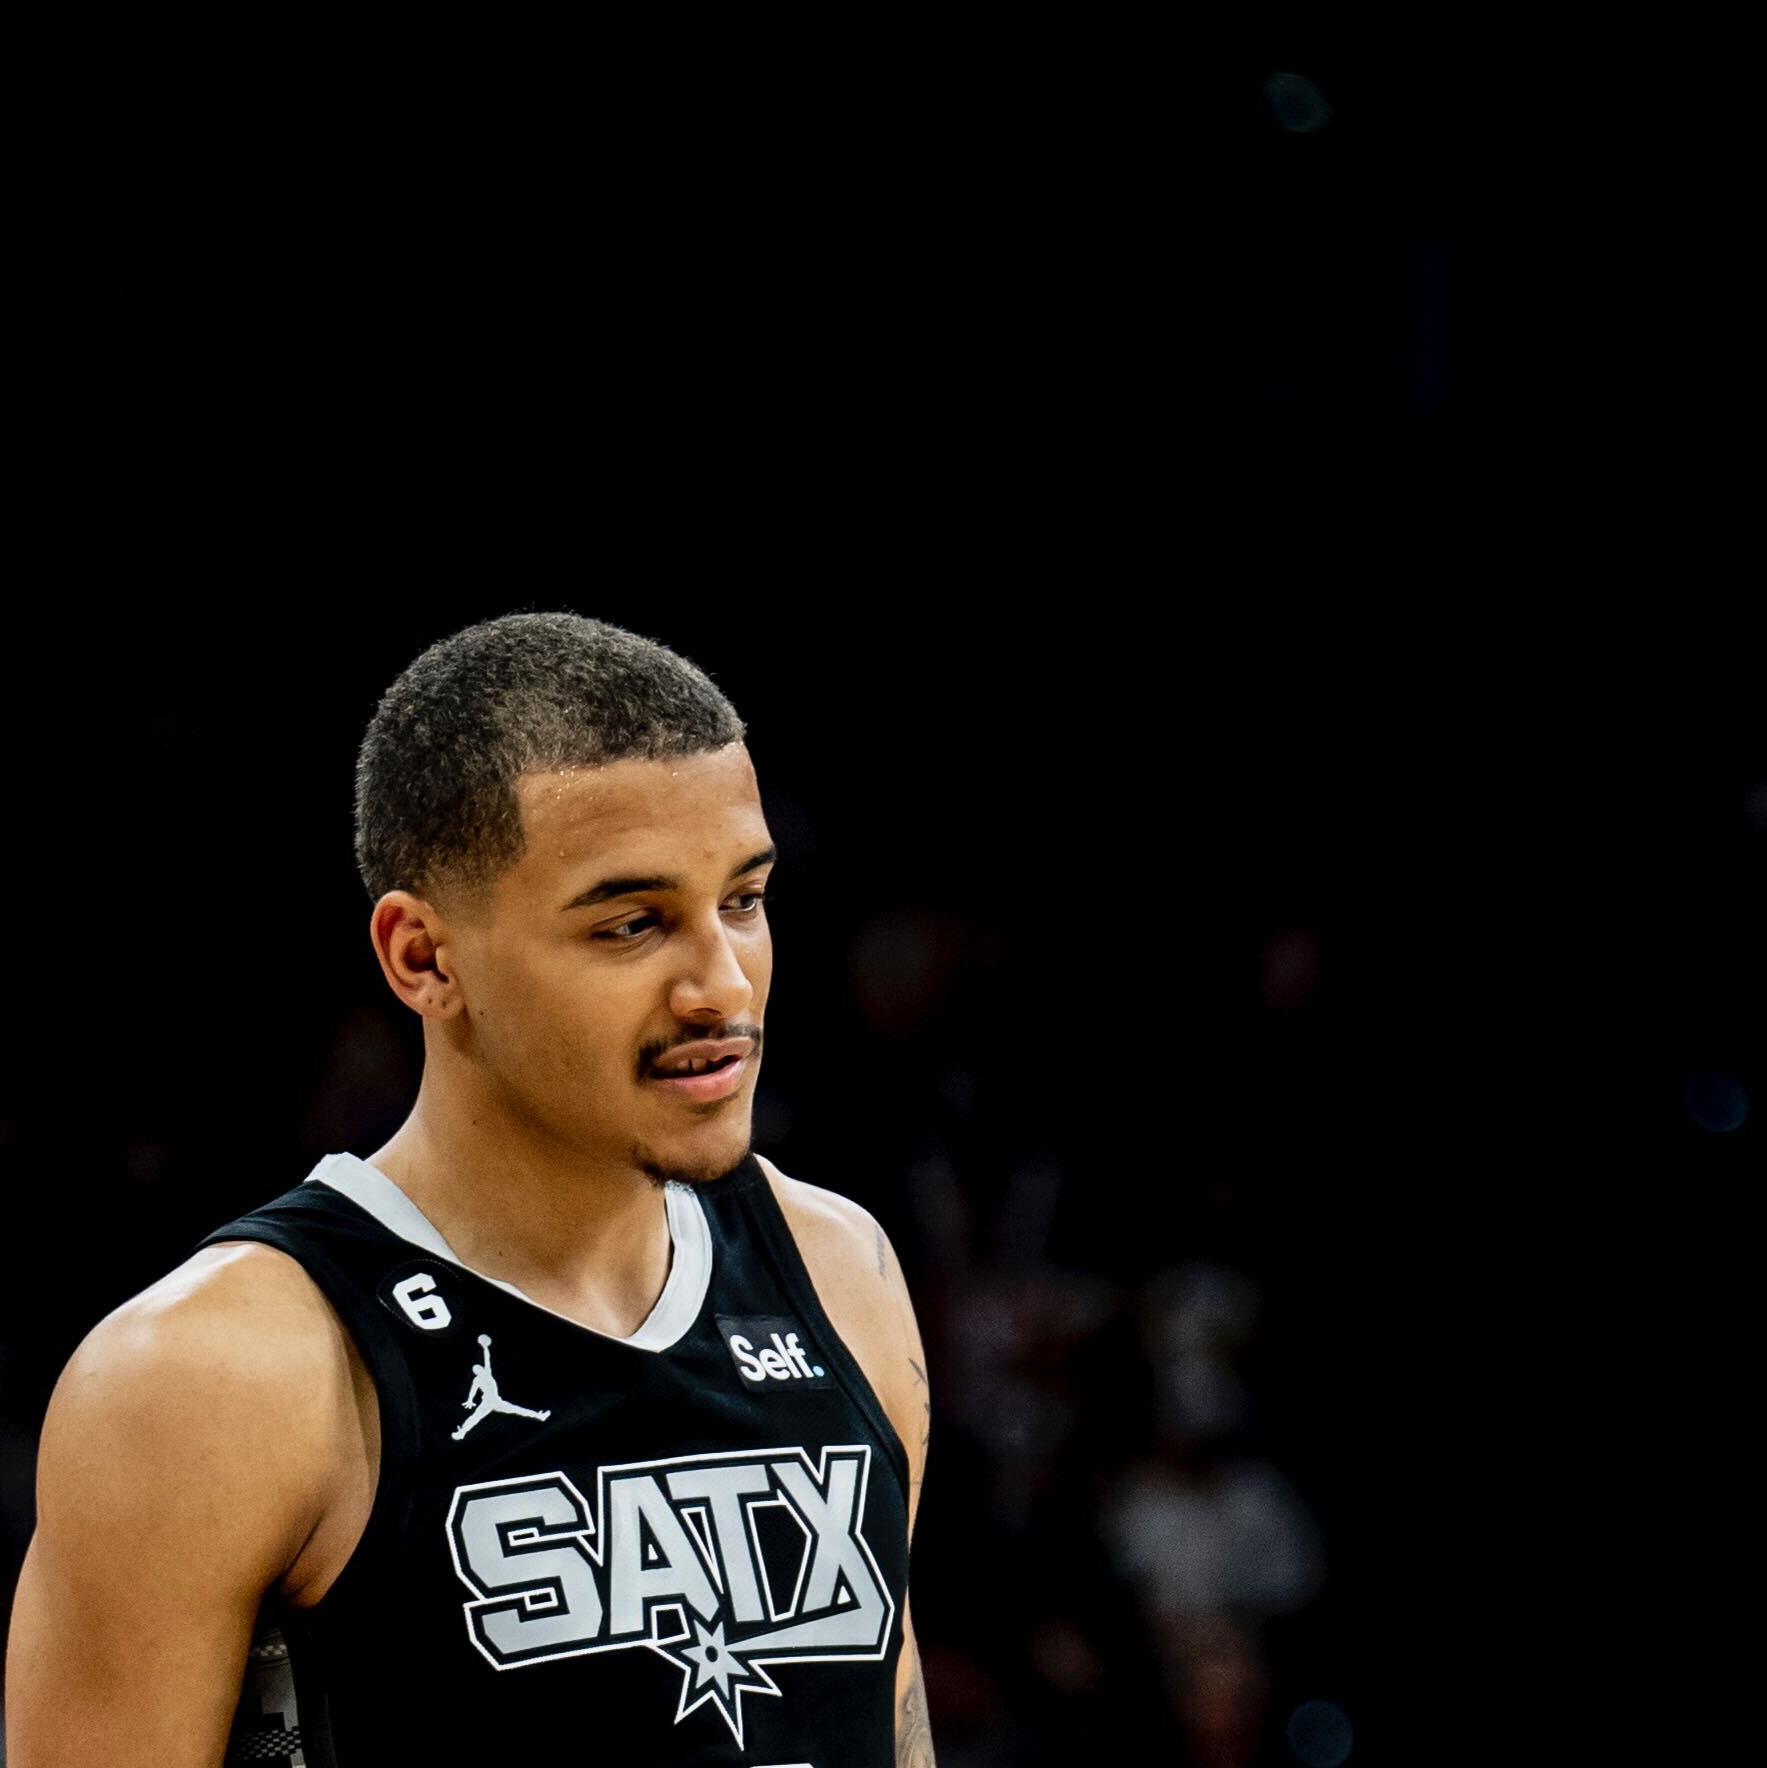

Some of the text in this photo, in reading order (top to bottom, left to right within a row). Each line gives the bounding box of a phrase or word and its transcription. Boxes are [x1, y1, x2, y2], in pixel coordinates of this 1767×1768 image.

[392, 1272, 452, 1331] 6
[730, 1333, 825, 1381] Self.
[445, 1445, 896, 1671] SATX
